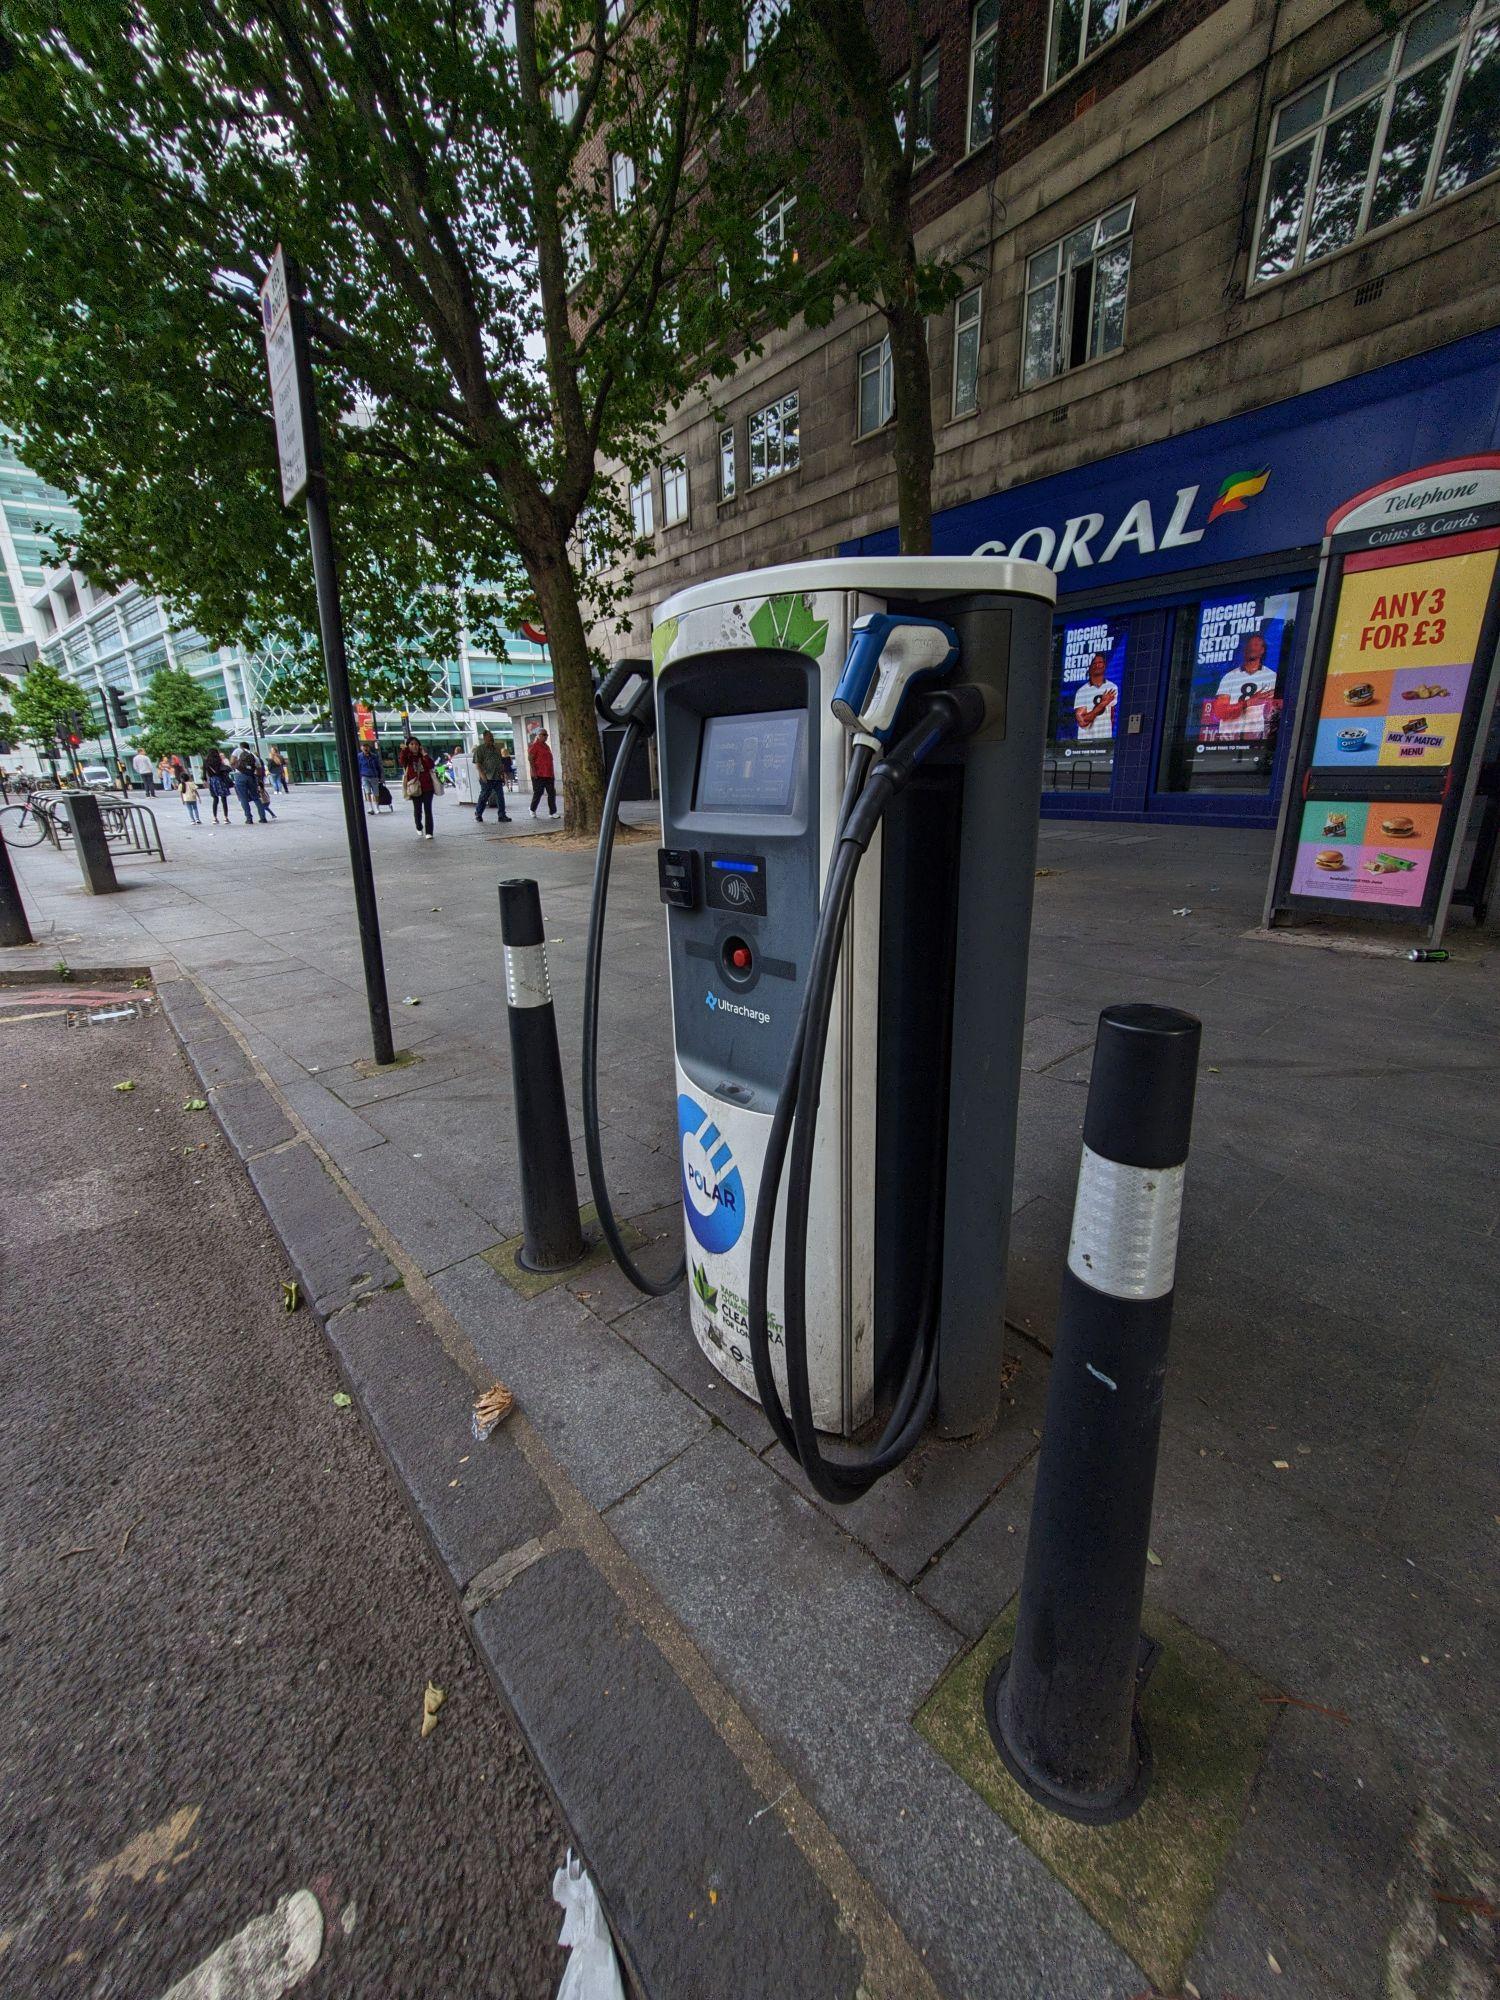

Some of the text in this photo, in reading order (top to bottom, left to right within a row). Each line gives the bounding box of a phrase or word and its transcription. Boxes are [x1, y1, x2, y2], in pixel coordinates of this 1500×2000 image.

[1385, 482, 1479, 513] Telephone
[1368, 512, 1480, 545] Coins & Cards
[1203, 601, 1256, 623] DIGGING
[1370, 588, 1446, 621] ANY 3
[1067, 624, 1108, 643] DIGGING
[1201, 616, 1264, 638] OUT THAT
[1360, 618, 1447, 651] FOR £3
[1066, 637, 1114, 656] OUT THAT
[1199, 634, 1240, 653] RETRO
[505, 691, 516, 699] STREET
[518, 688, 531, 697] STATION
[1387, 733, 1403, 742] MIX
[1413, 736, 1442, 746] MATCH
[1400, 747, 1423, 757] MENU
[717, 998, 770, 1024] Ultracharge
[688, 1162, 736, 1212] POLAR
[721, 1284, 739, 1302] RAPID
[723, 1316, 735, 1330] FOR
